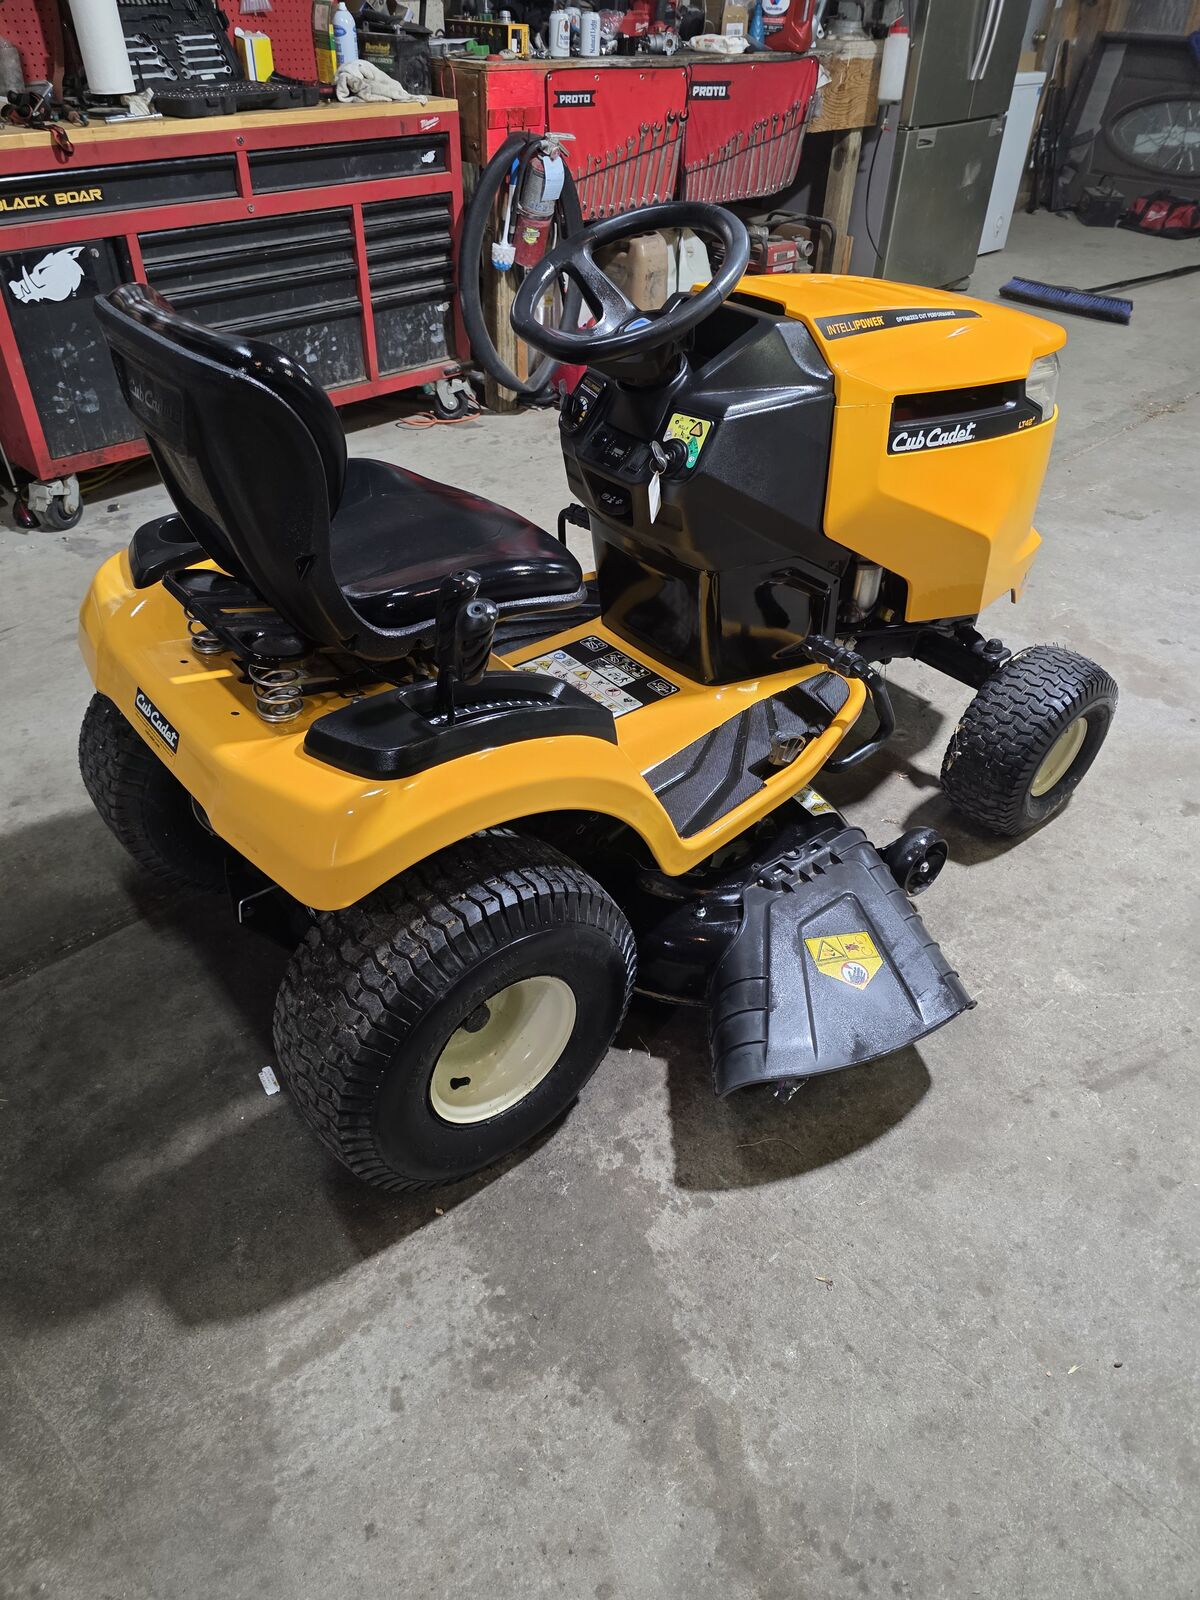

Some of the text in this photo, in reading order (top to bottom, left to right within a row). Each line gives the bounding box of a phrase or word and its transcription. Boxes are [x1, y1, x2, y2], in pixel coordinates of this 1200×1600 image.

[559, 94, 591, 104] PROTO
[692, 85, 726, 97] PROTO
[54, 188, 103, 206] BOAR
[826, 315, 885, 336] INTELLIPOWER
[892, 421, 977, 452] Cub Cadet
[136, 693, 152, 718] Cub
[150, 711, 177, 747] Cadet
